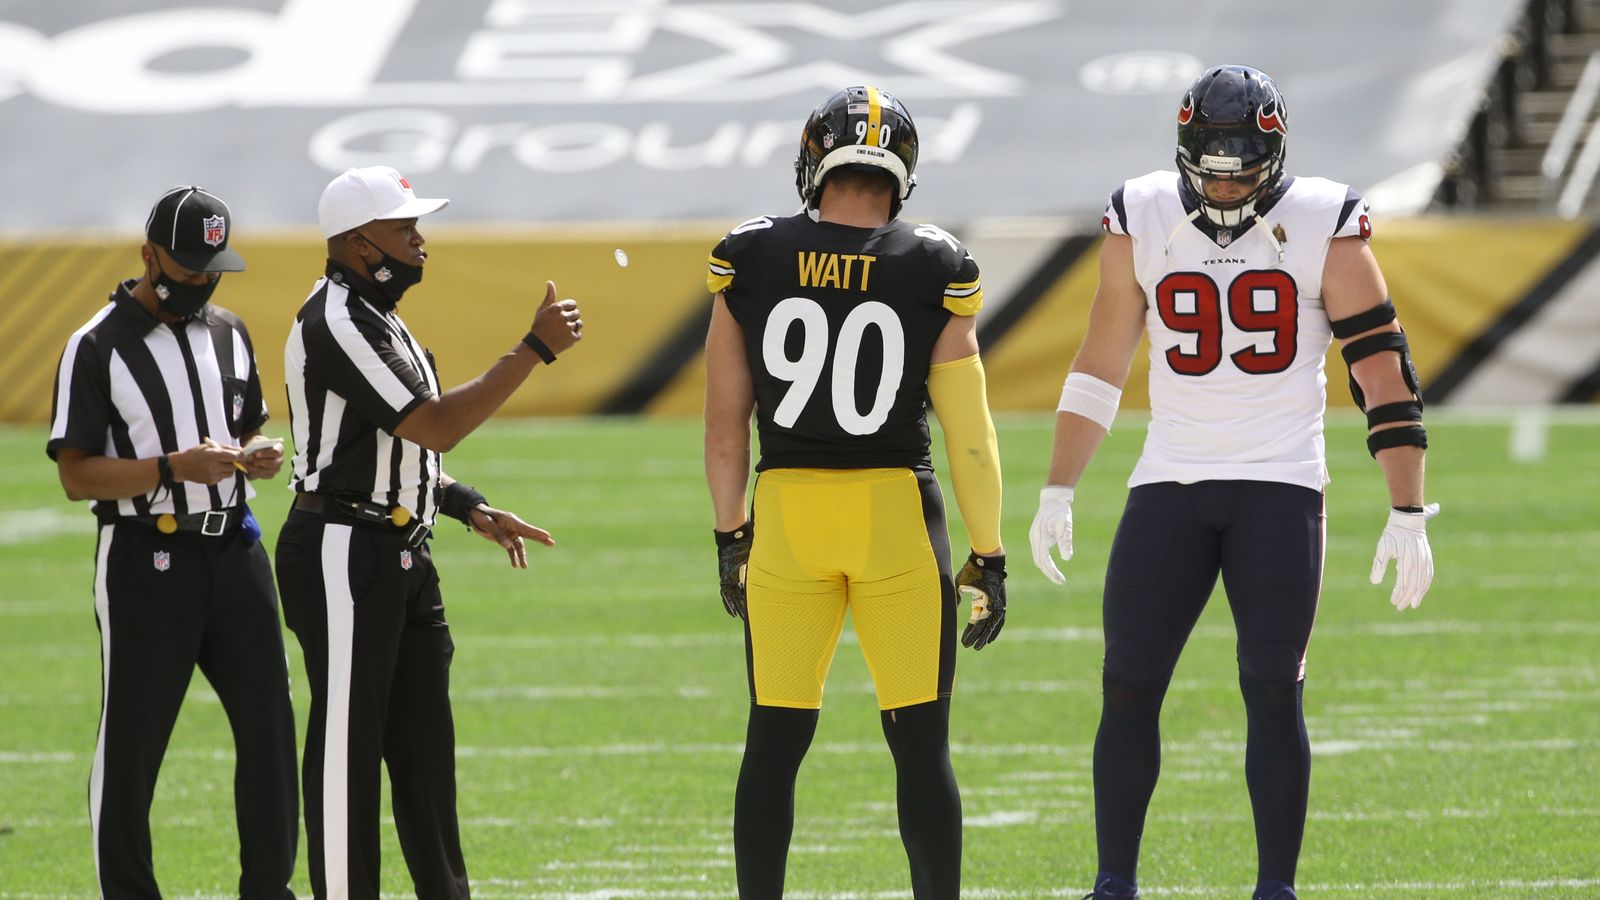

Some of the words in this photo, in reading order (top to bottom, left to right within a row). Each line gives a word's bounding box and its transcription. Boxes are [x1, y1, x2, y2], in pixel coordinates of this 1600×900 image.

[798, 251, 877, 292] WATT
[1202, 257, 1247, 266] TEXANS
[1155, 268, 1299, 377] 99
[762, 296, 905, 436] 90
